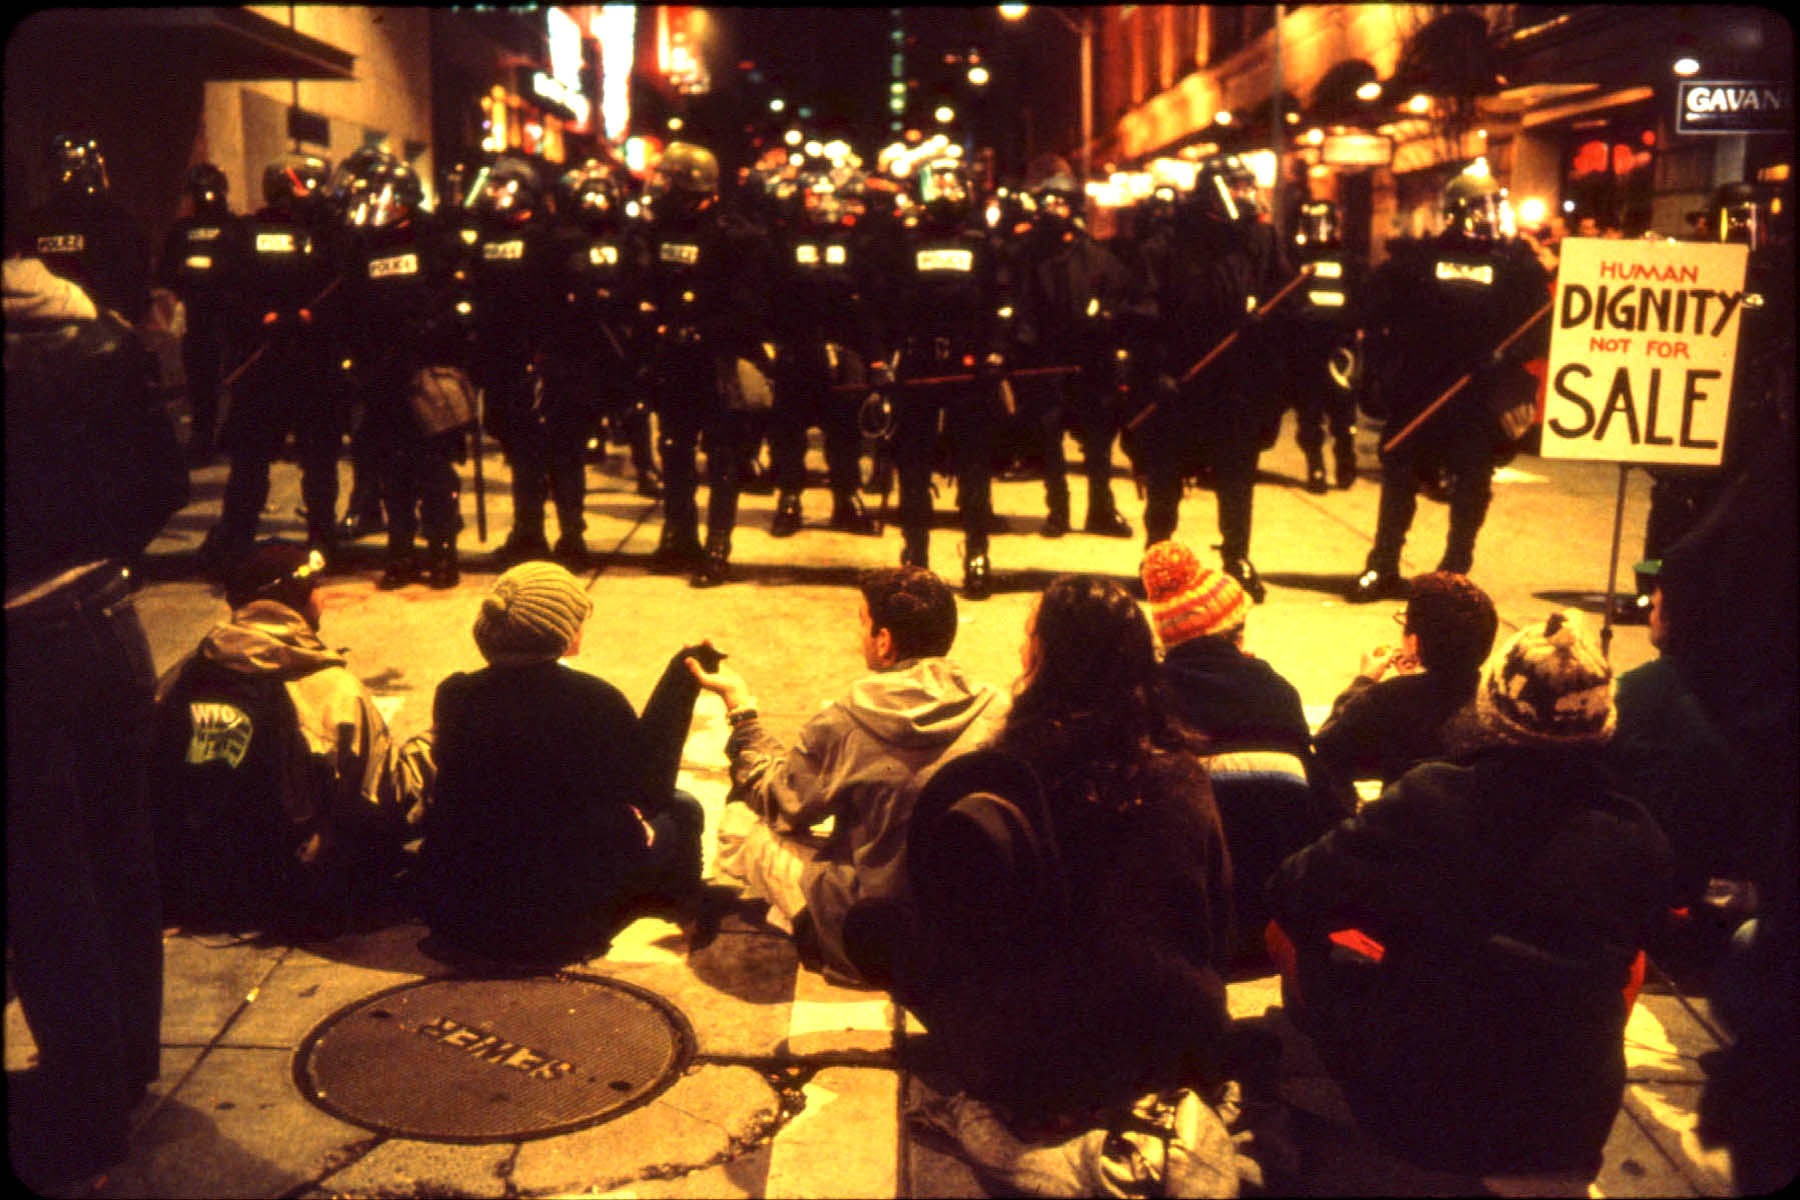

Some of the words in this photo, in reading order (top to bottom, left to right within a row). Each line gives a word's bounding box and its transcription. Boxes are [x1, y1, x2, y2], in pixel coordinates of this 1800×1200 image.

[1600, 261, 1698, 283] HUMAN
[1560, 284, 1743, 338] DIGNITY
[1589, 336, 1632, 354] NOT
[1645, 340, 1690, 360] FOR
[1548, 362, 1722, 449] SALE
[419, 1016, 576, 1080] SEWER
